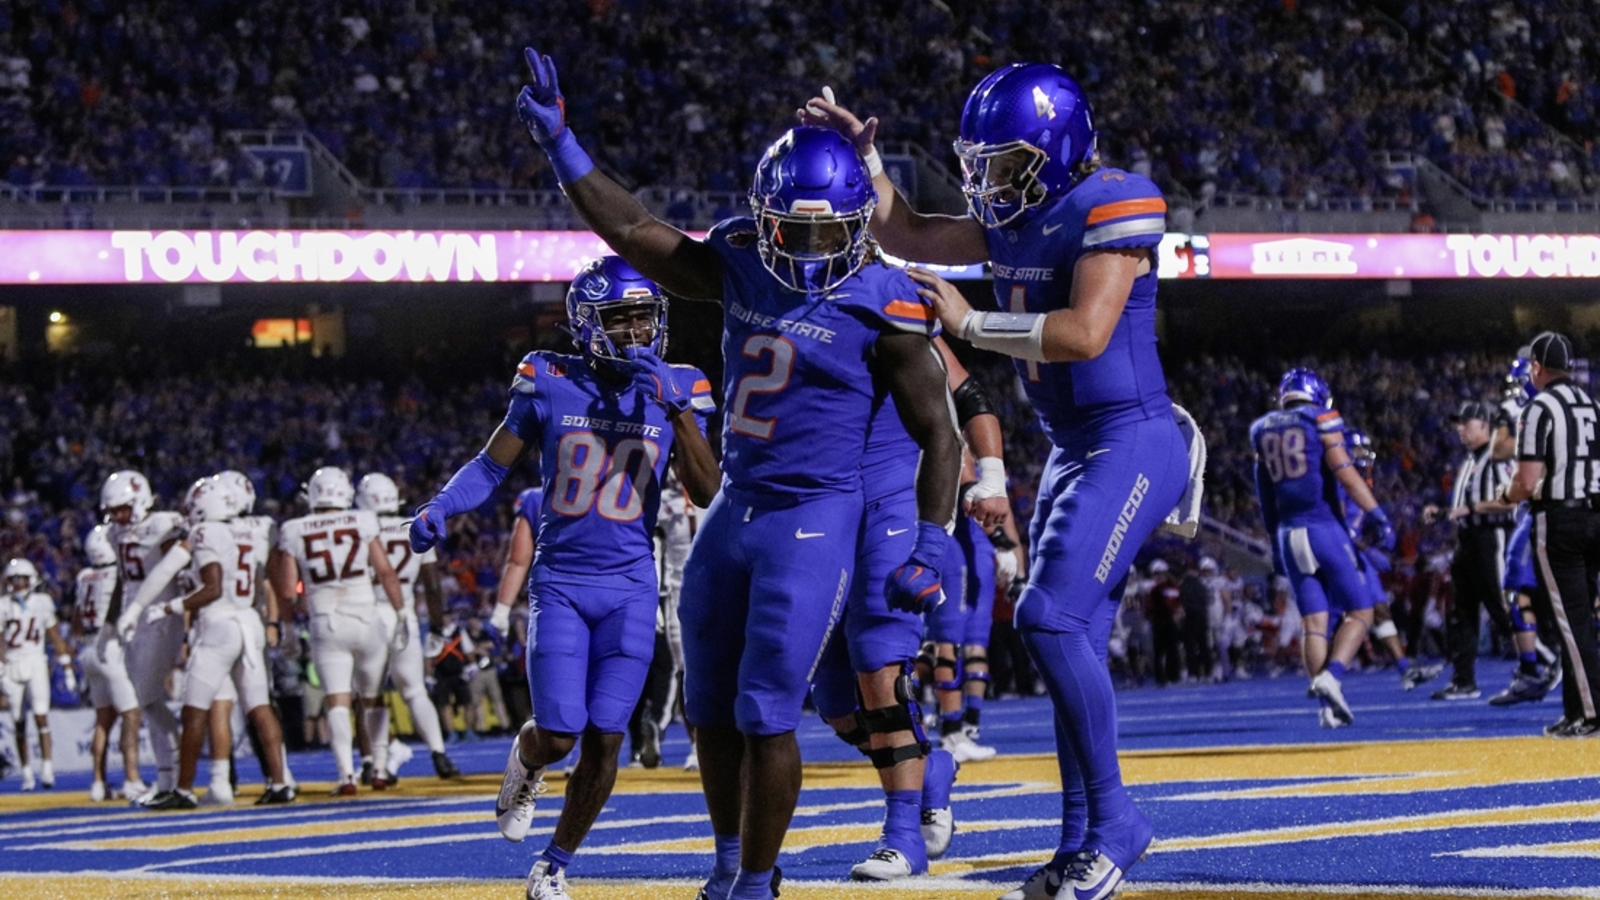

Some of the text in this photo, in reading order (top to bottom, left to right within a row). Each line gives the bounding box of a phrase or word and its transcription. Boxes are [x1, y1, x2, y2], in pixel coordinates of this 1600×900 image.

[111, 230, 499, 282] TOUCHDOWN
[1013, 267, 1054, 281] STATE
[729, 302, 836, 343] BOISE STATE
[731, 333, 797, 441] 2
[561, 415, 662, 438] BOISE STATE
[1572, 407, 1597, 456] F
[551, 431, 661, 522] 80
[1261, 426, 1308, 483] 88
[303, 515, 357, 531] THORNTON
[1094, 473, 1150, 584] BRONCOS
[119, 543, 146, 580] 15
[236, 544, 253, 597] 5
[302, 528, 364, 584] 52
[6, 617, 40, 649] 24
